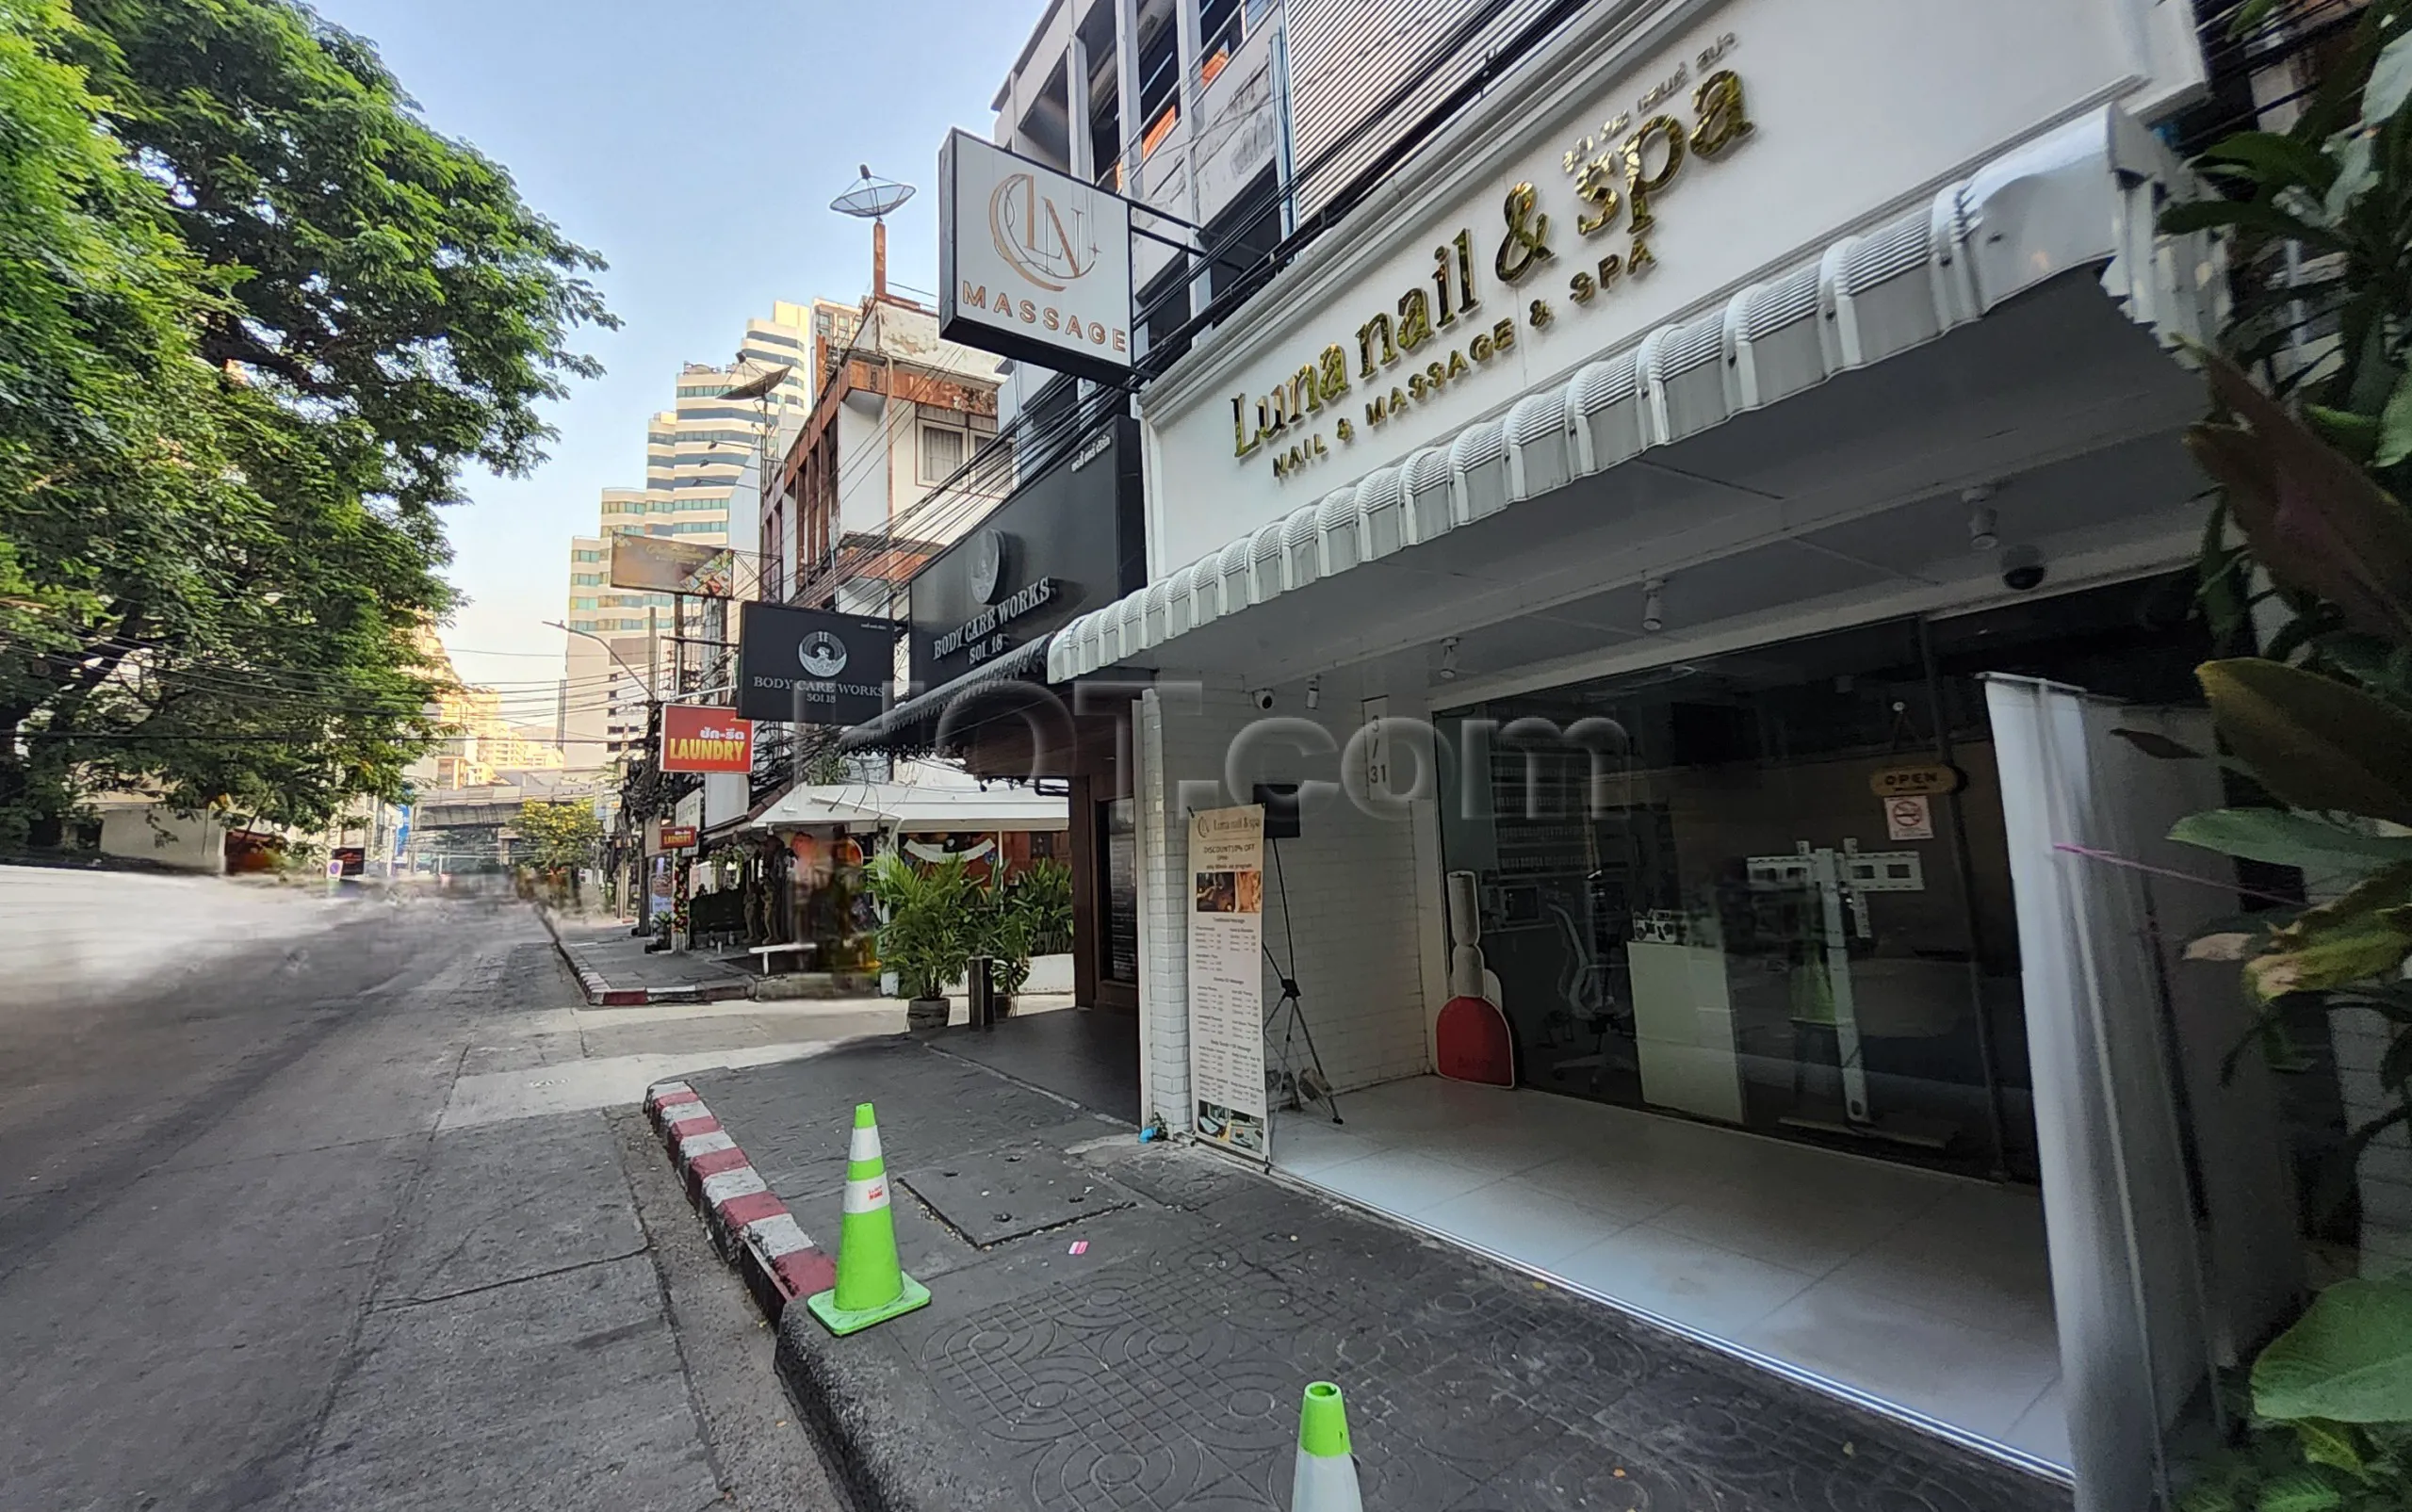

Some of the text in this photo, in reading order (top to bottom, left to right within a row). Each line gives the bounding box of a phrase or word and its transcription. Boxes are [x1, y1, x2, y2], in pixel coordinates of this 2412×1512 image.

[1230, 70, 1755, 458] Luna nail & spa
[962, 281, 1126, 352] MASSAGE
[1272, 433, 1328, 479] NAIL
[1365, 317, 1516, 427] MASSAGE
[1529, 299, 1552, 328] &
[1569, 237, 1657, 305] SPA
[934, 576, 1051, 660] BODY CARE WORKS
[969, 633, 1003, 665] SOI 18
[754, 676, 885, 697] BODY CARE WORKS
[806, 692, 837, 704] SOI 18
[670, 738, 745, 761] LAUNDRY
[1885, 772, 1938, 786] OPEN
